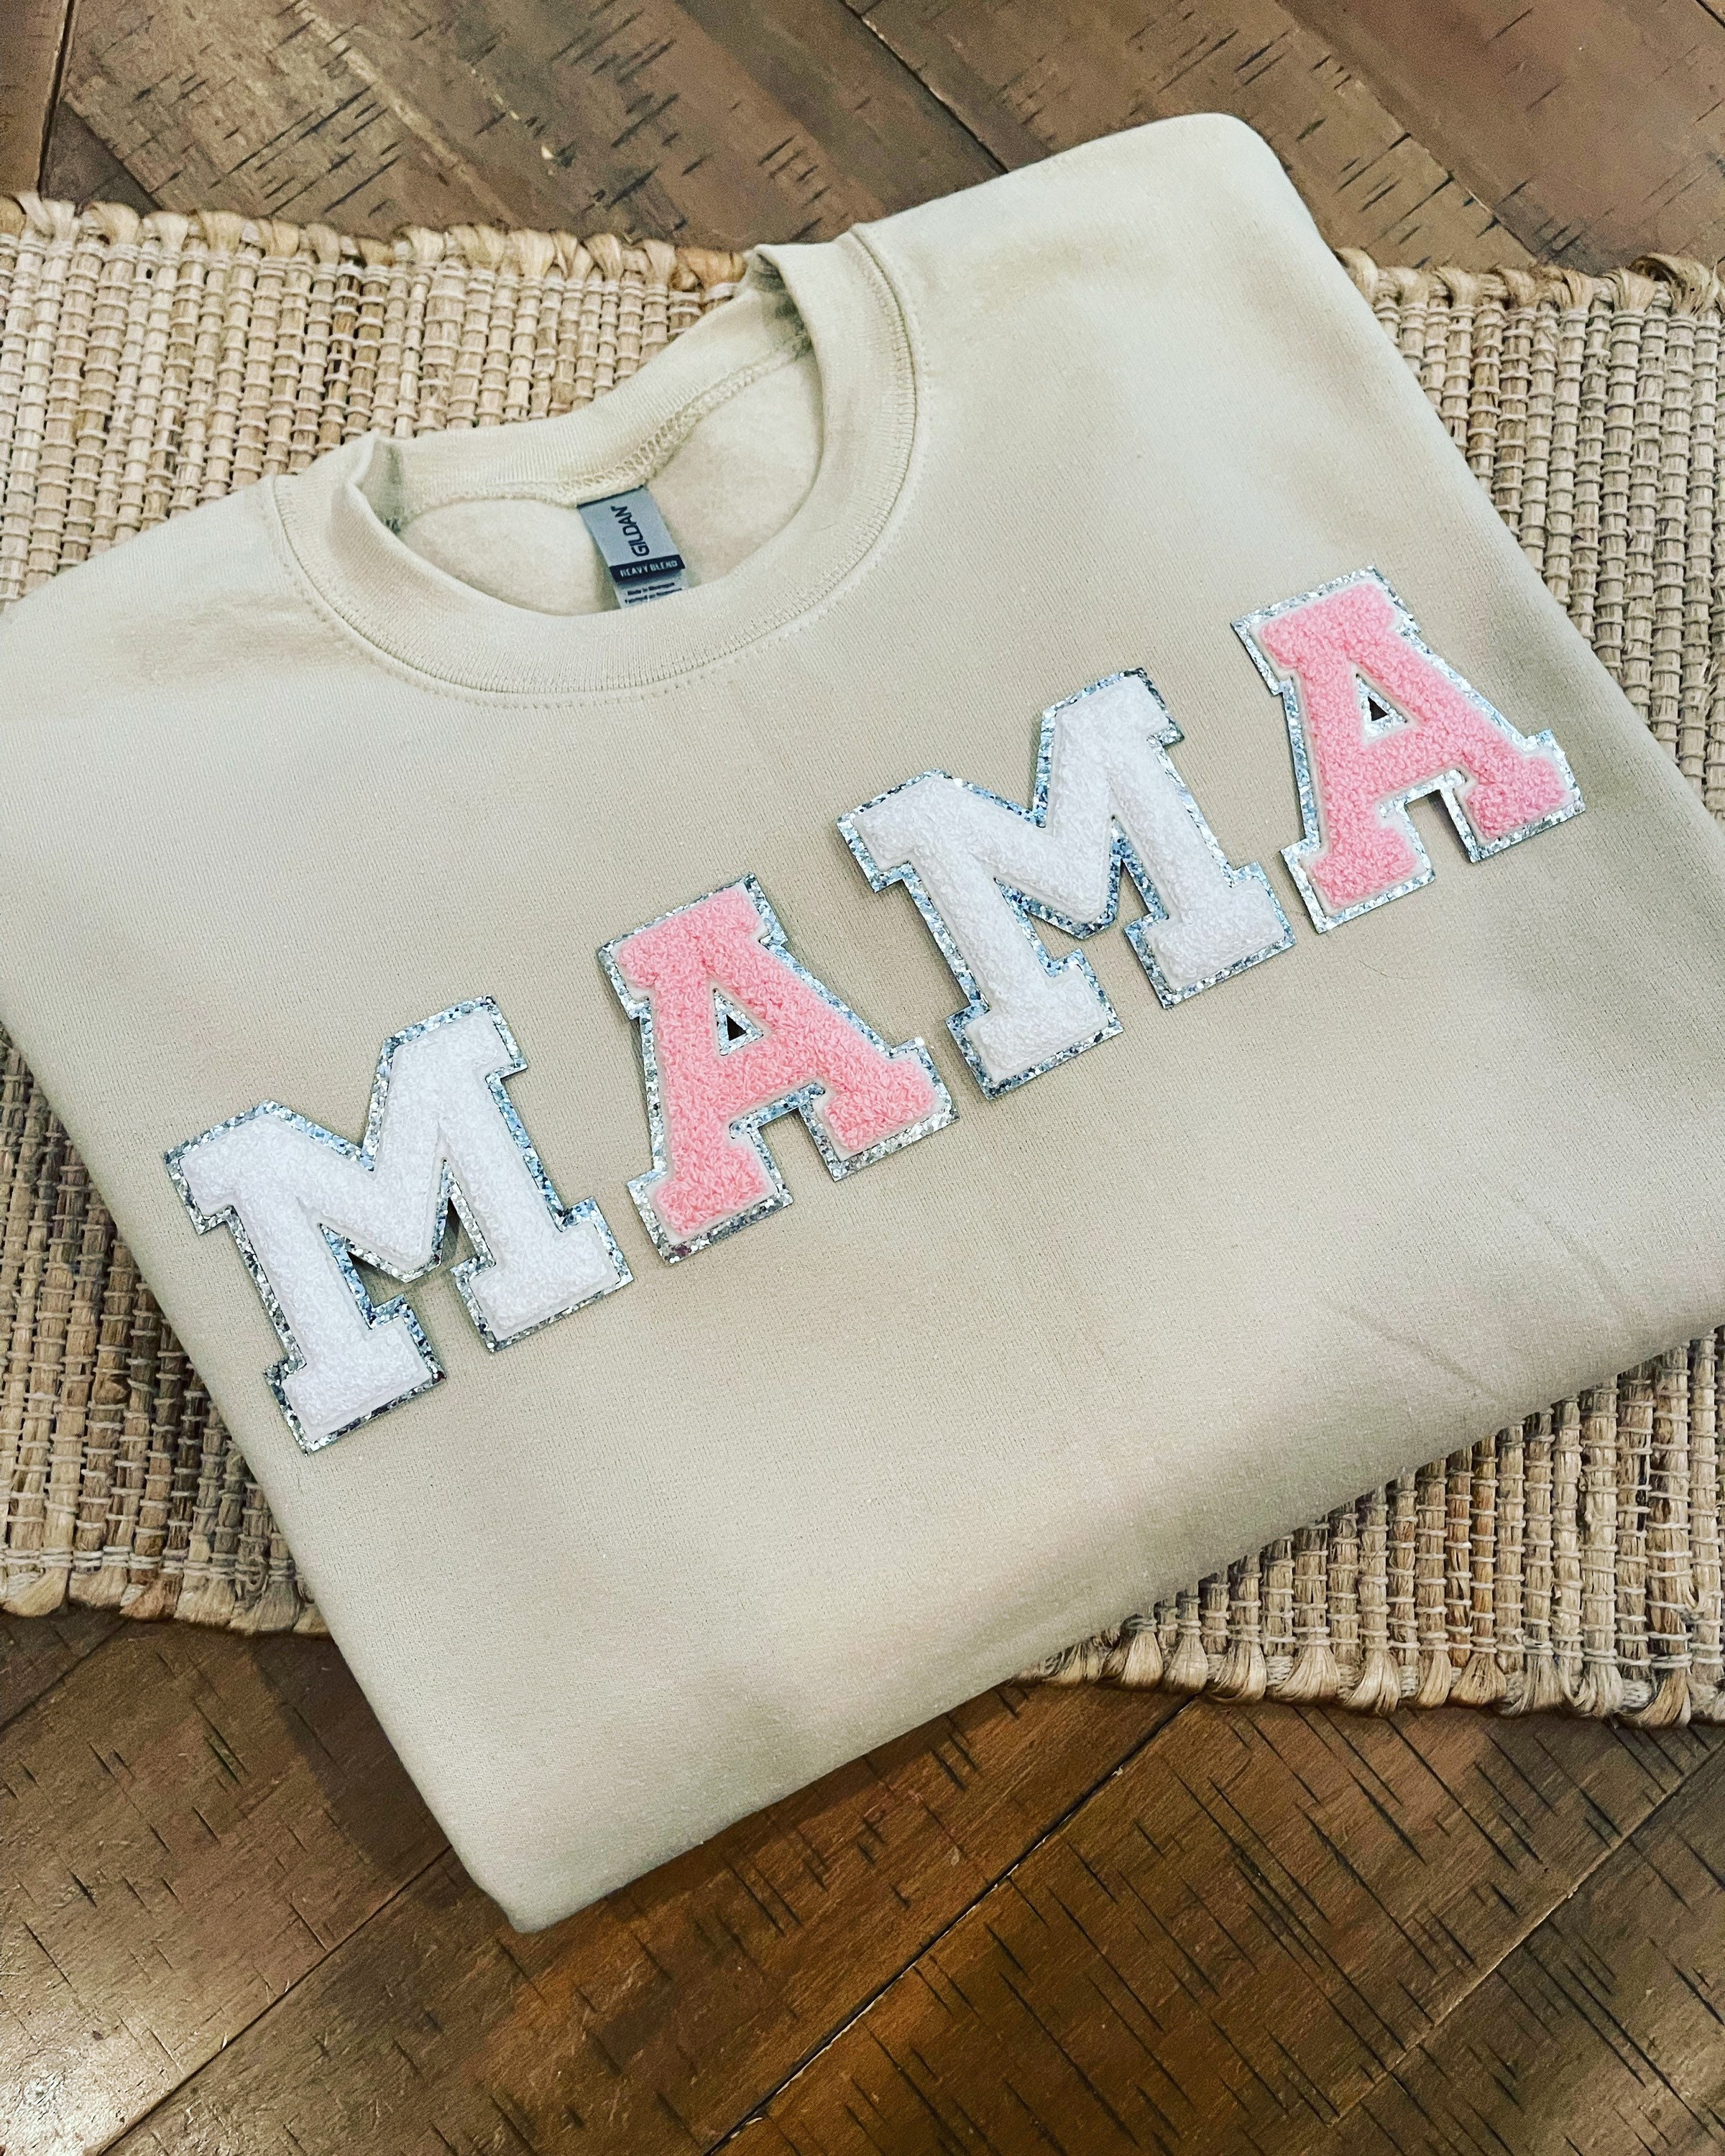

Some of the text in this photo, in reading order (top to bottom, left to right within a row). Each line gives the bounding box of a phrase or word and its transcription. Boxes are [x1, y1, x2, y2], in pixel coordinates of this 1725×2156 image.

[613, 506, 650, 556] GILDAN
[620, 561, 678, 577] HEAVY BLEND
[163, 567, 1586, 1454] MAMA
